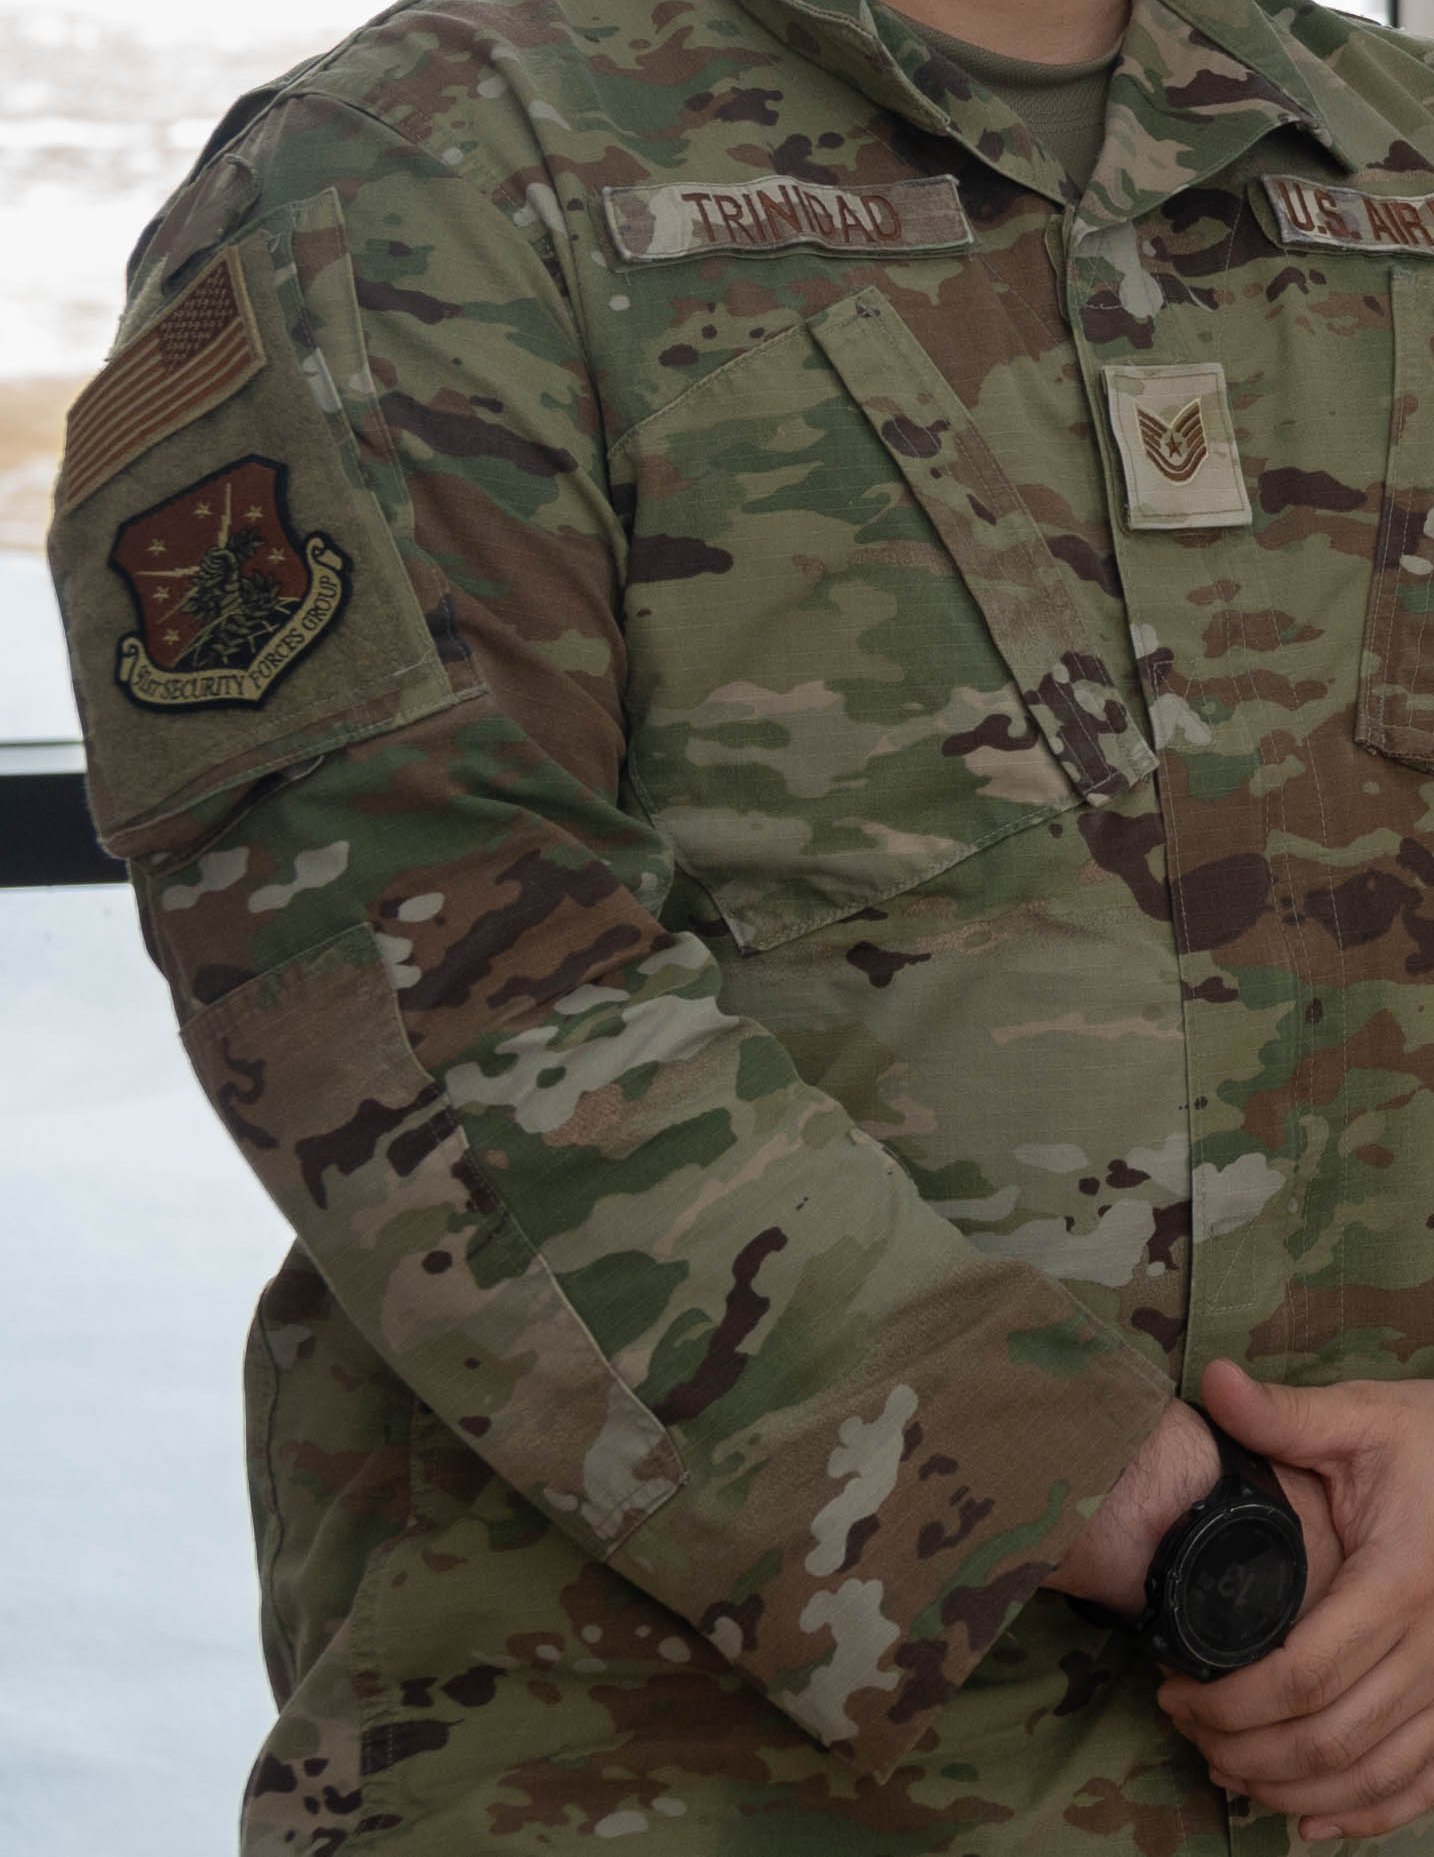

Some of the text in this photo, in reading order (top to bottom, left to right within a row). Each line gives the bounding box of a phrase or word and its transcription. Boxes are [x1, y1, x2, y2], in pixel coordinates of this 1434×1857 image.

[680, 184, 902, 244] TRINIDAD
[1276, 182, 1363, 240] U.S.
[160, 674, 247, 700] SECURITY
[248, 628, 305, 690] FORCES
[301, 574, 338, 632] GROUP
